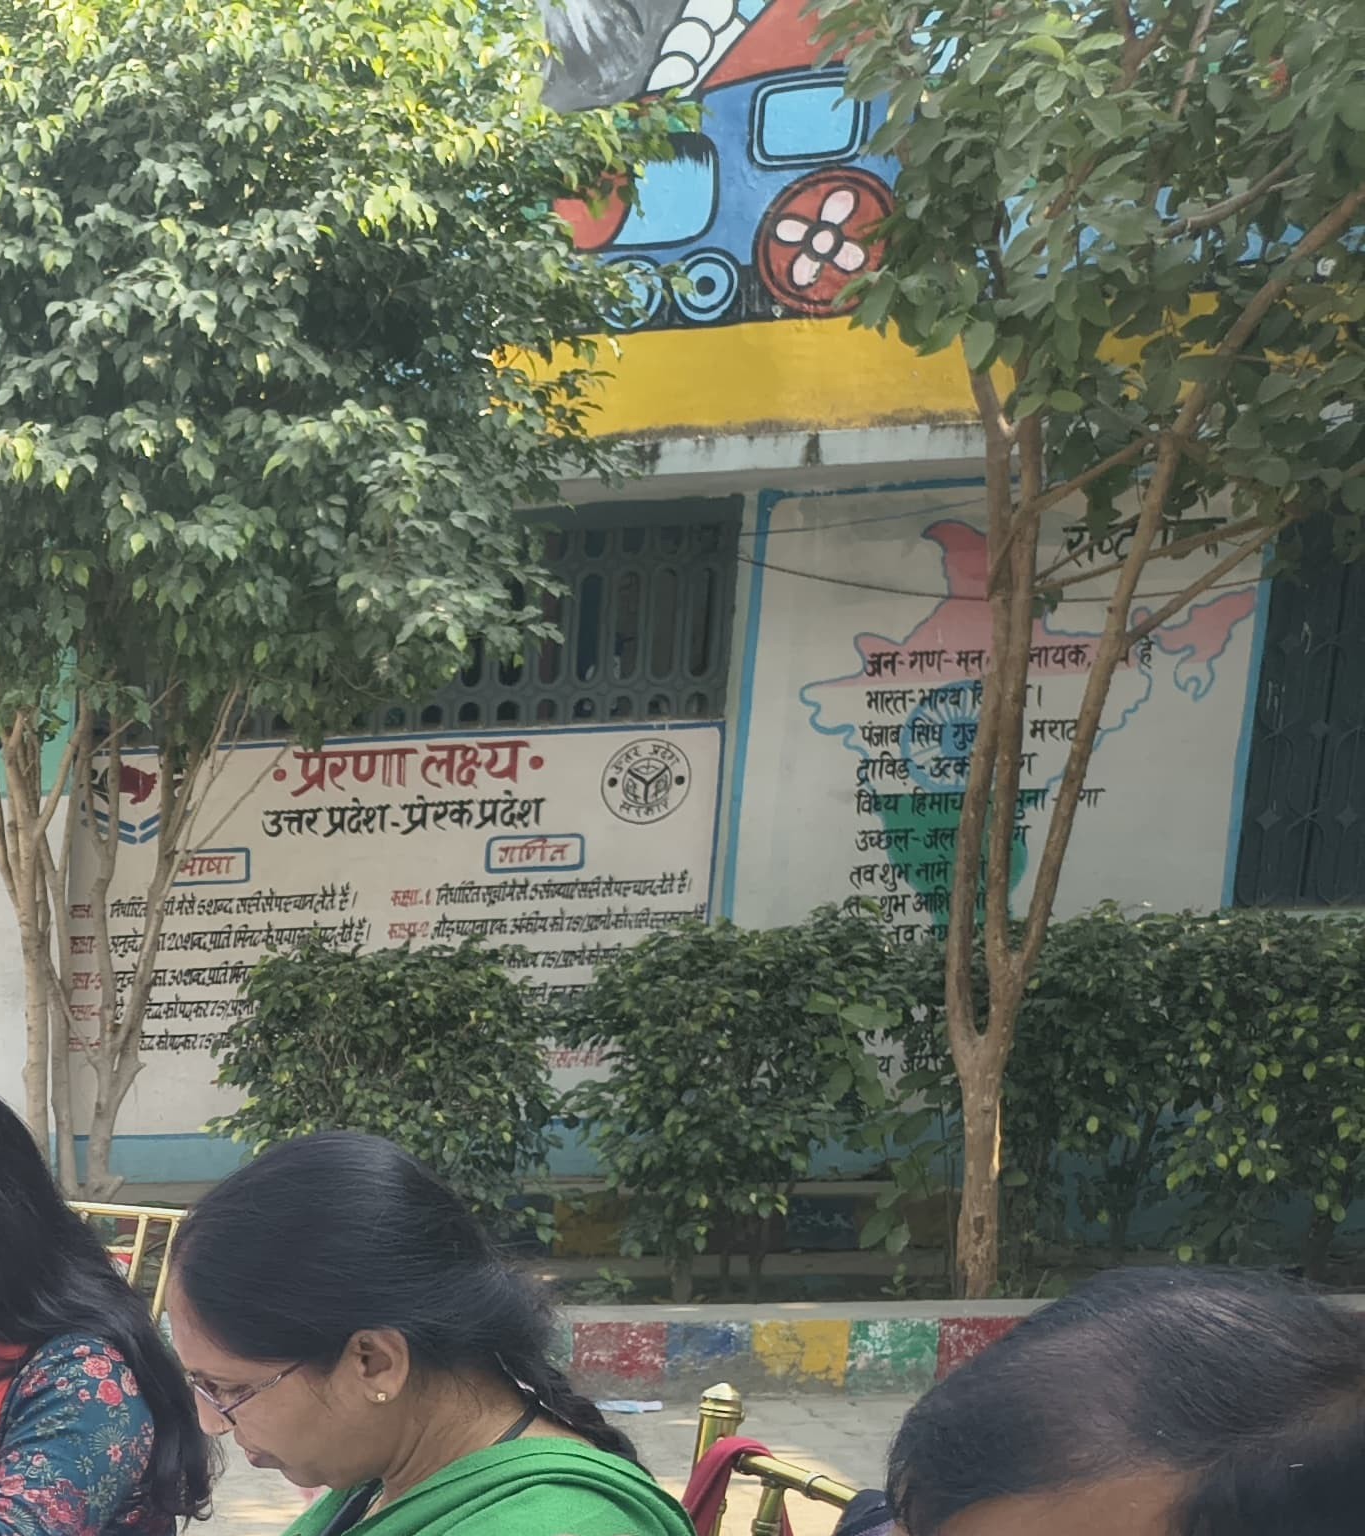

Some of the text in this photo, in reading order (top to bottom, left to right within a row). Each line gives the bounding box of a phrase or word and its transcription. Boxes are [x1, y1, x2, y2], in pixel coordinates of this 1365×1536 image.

[859, 717, 901, 749] पंजाब
[421, 741, 531, 789] लक्ष्य
[261, 806, 323, 838] उत्तर
[475, 789, 547, 830] प्रदेश
[911, 786, 965, 817] हिमाच
[497, 837, 571, 864] गणित
